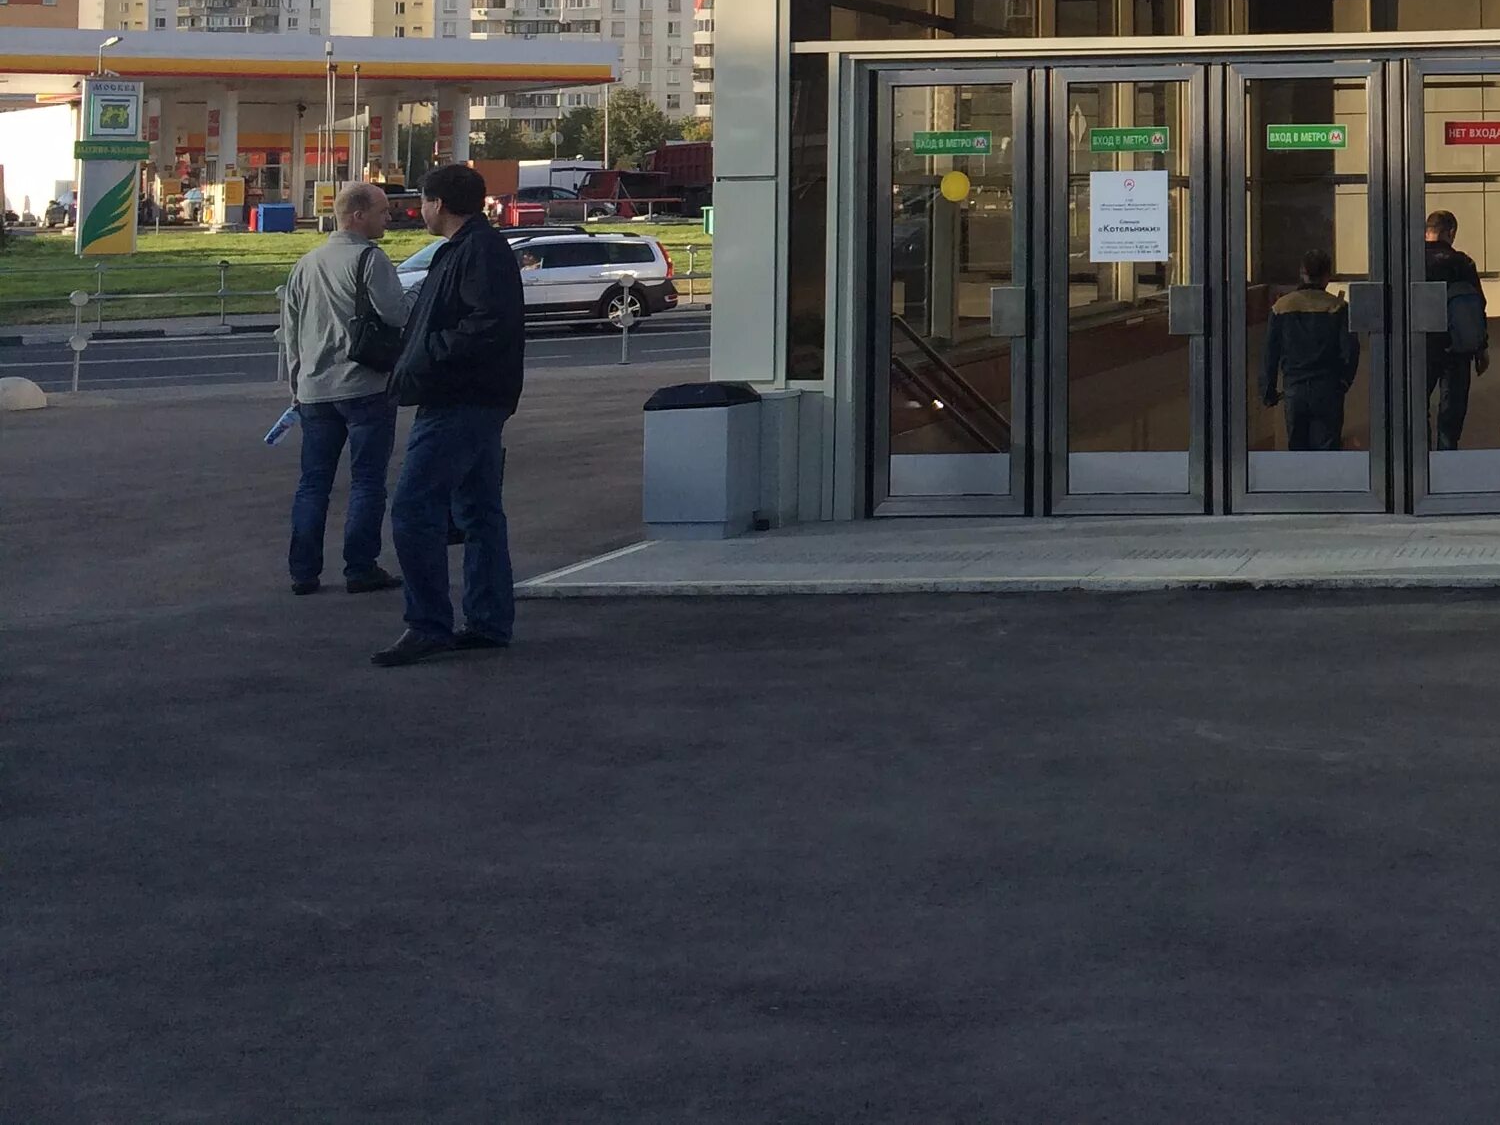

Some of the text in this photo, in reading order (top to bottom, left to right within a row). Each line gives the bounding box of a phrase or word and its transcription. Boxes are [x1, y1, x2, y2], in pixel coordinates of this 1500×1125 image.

[1270, 132, 1292, 143] ВХОД
[1293, 132, 1299, 142] В
[1300, 132, 1327, 142] МЕТРО
[1449, 128, 1467, 138] НЕТ
[915, 138, 937, 149] ВХОД
[938, 138, 944, 148] В
[945, 138, 972, 148] МЕТРО
[1093, 135, 1114, 146] ВХОД
[1115, 135, 1121, 144] В
[1122, 135, 1149, 145] МЕТРО
